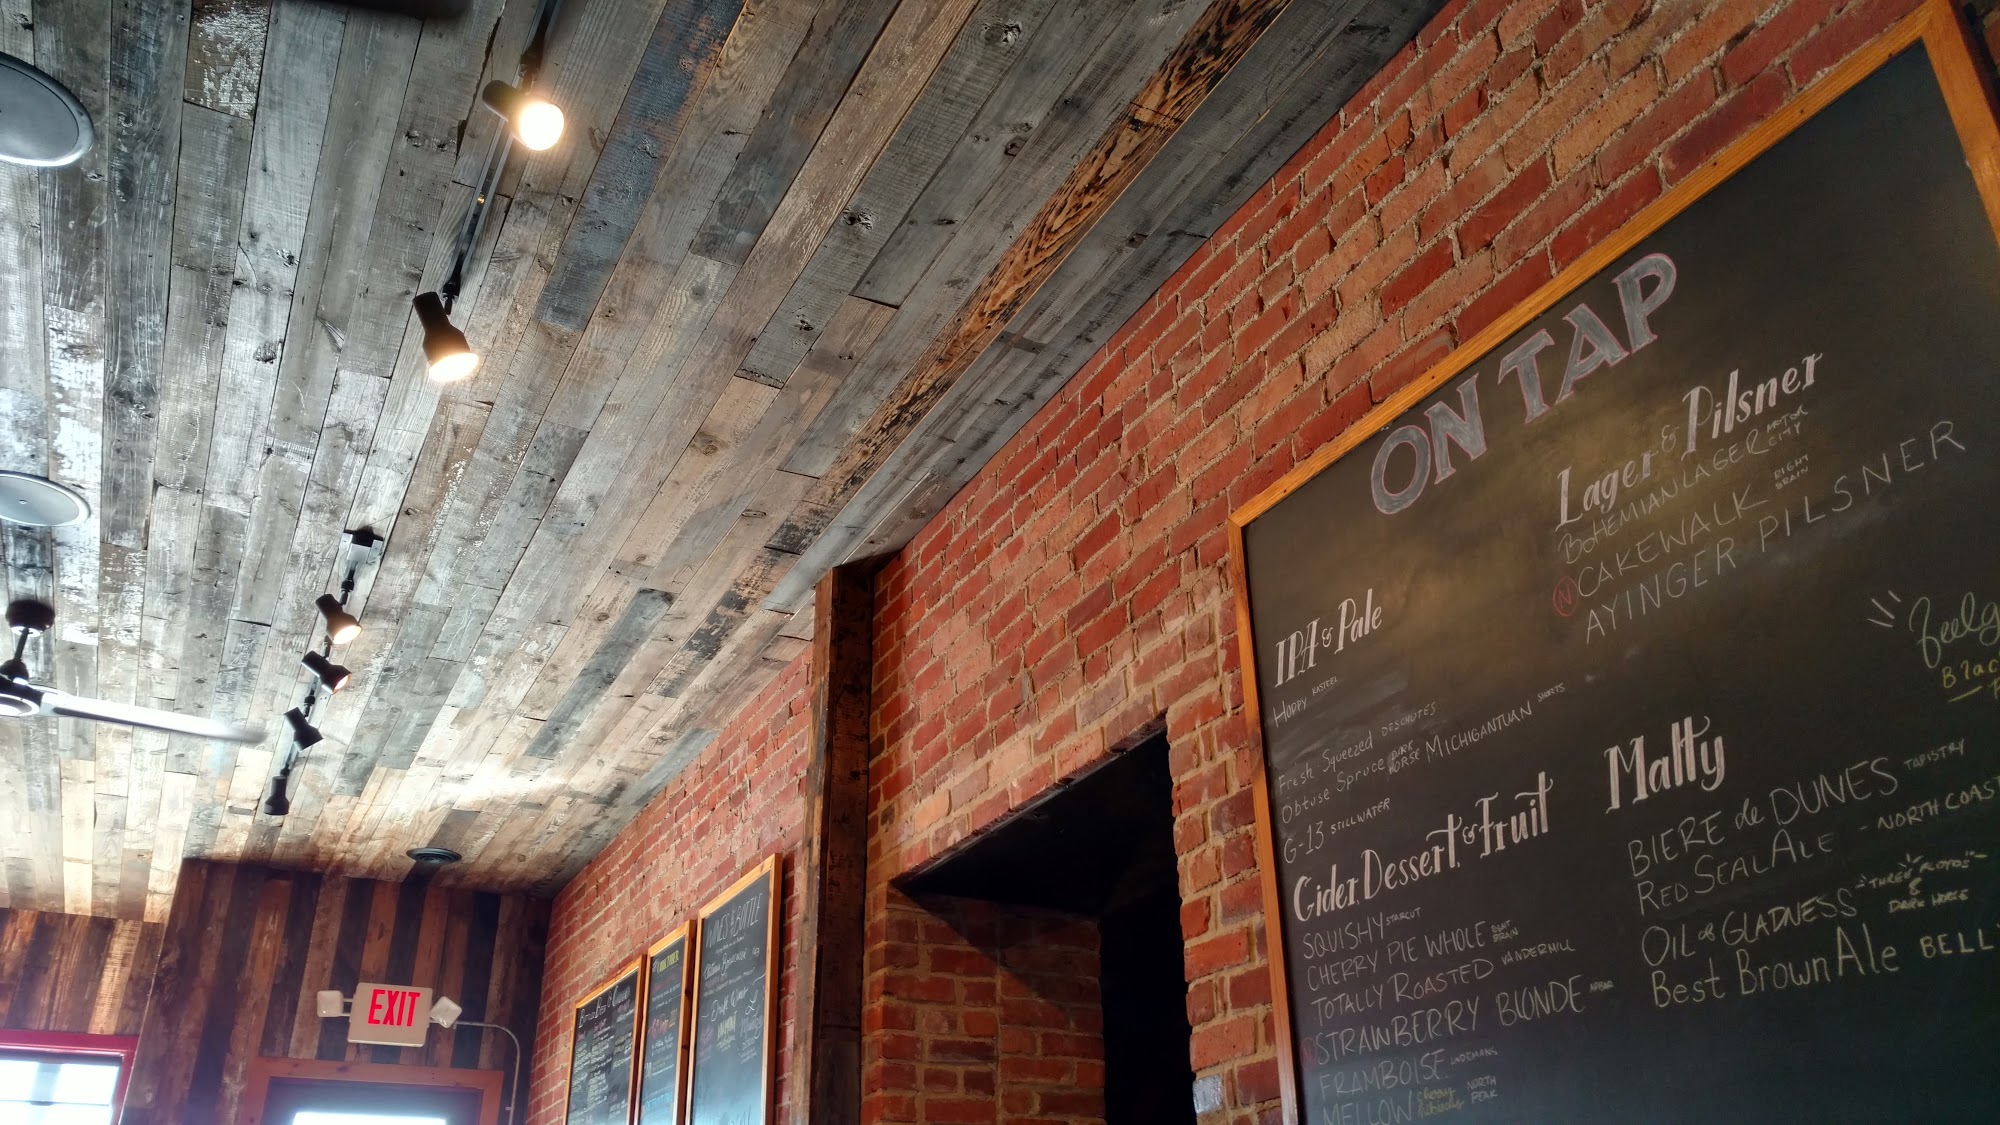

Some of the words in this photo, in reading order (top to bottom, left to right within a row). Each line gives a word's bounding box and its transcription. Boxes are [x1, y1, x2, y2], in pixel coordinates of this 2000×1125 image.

[1370, 373, 1487, 515] ON
[1498, 252, 1677, 424] TAP
[1555, 450, 1659, 532] Lager
[1681, 353, 1823, 462] Pilsner
[1768, 421, 1801, 447] CITY
[1773, 453, 1809, 480] RIGHT
[1775, 465, 1809, 490] BRAIN
[1578, 484, 1769, 597] CAKEWALK
[1586, 537, 1737, 645] AYINGER
[1759, 420, 1966, 552] PILSNER
[1274, 617, 1321, 688] IPA
[1334, 588, 1382, 655] Pale
[1278, 761, 1315, 796] Fresh
[1321, 730, 1374, 773] Squeezed
[1381, 701, 1437, 738] DESCHUTES
[1603, 715, 1726, 815] Malty
[1281, 788, 1331, 824] Obtuse
[1337, 757, 1386, 792] Spruce
[1283, 820, 1324, 864] G-13
[1330, 797, 1391, 835] STILLWATER
[1475, 771, 1554, 859] Fruit
[1628, 810, 1726, 877] BIERE
[1735, 797, 1766, 831] de
[1769, 756, 1899, 826] DUNES
[1637, 880, 1689, 917] RED
[1694, 854, 1771, 894] SEAL
[1771, 828, 1834, 869] ALE
[1877, 797, 1939, 831] NORTH
[1303, 911, 1384, 959] SQUISHY
[1307, 949, 1378, 991] CHERRY
[1386, 936, 1419, 965] PIE
[1424, 920, 1486, 958] WHOLE
[1641, 922, 1696, 967] OIL
[1721, 887, 1857, 946] GLADNESS
[1652, 957, 1726, 1008] Best
[1736, 948, 1832, 995] Brown
[1836, 922, 1900, 977] Ale
[367, 988, 422, 1027] EXIT
[1311, 984, 1384, 1026] TOTALLY
[1387, 958, 1494, 1002] ROASTED
[1316, 995, 1480, 1065] STRAWBERRY
[1495, 974, 1586, 1027] BLONDE
[1319, 1048, 1446, 1101] FRAMBOISE
[1323, 1090, 1413, 1125] MELLOW
